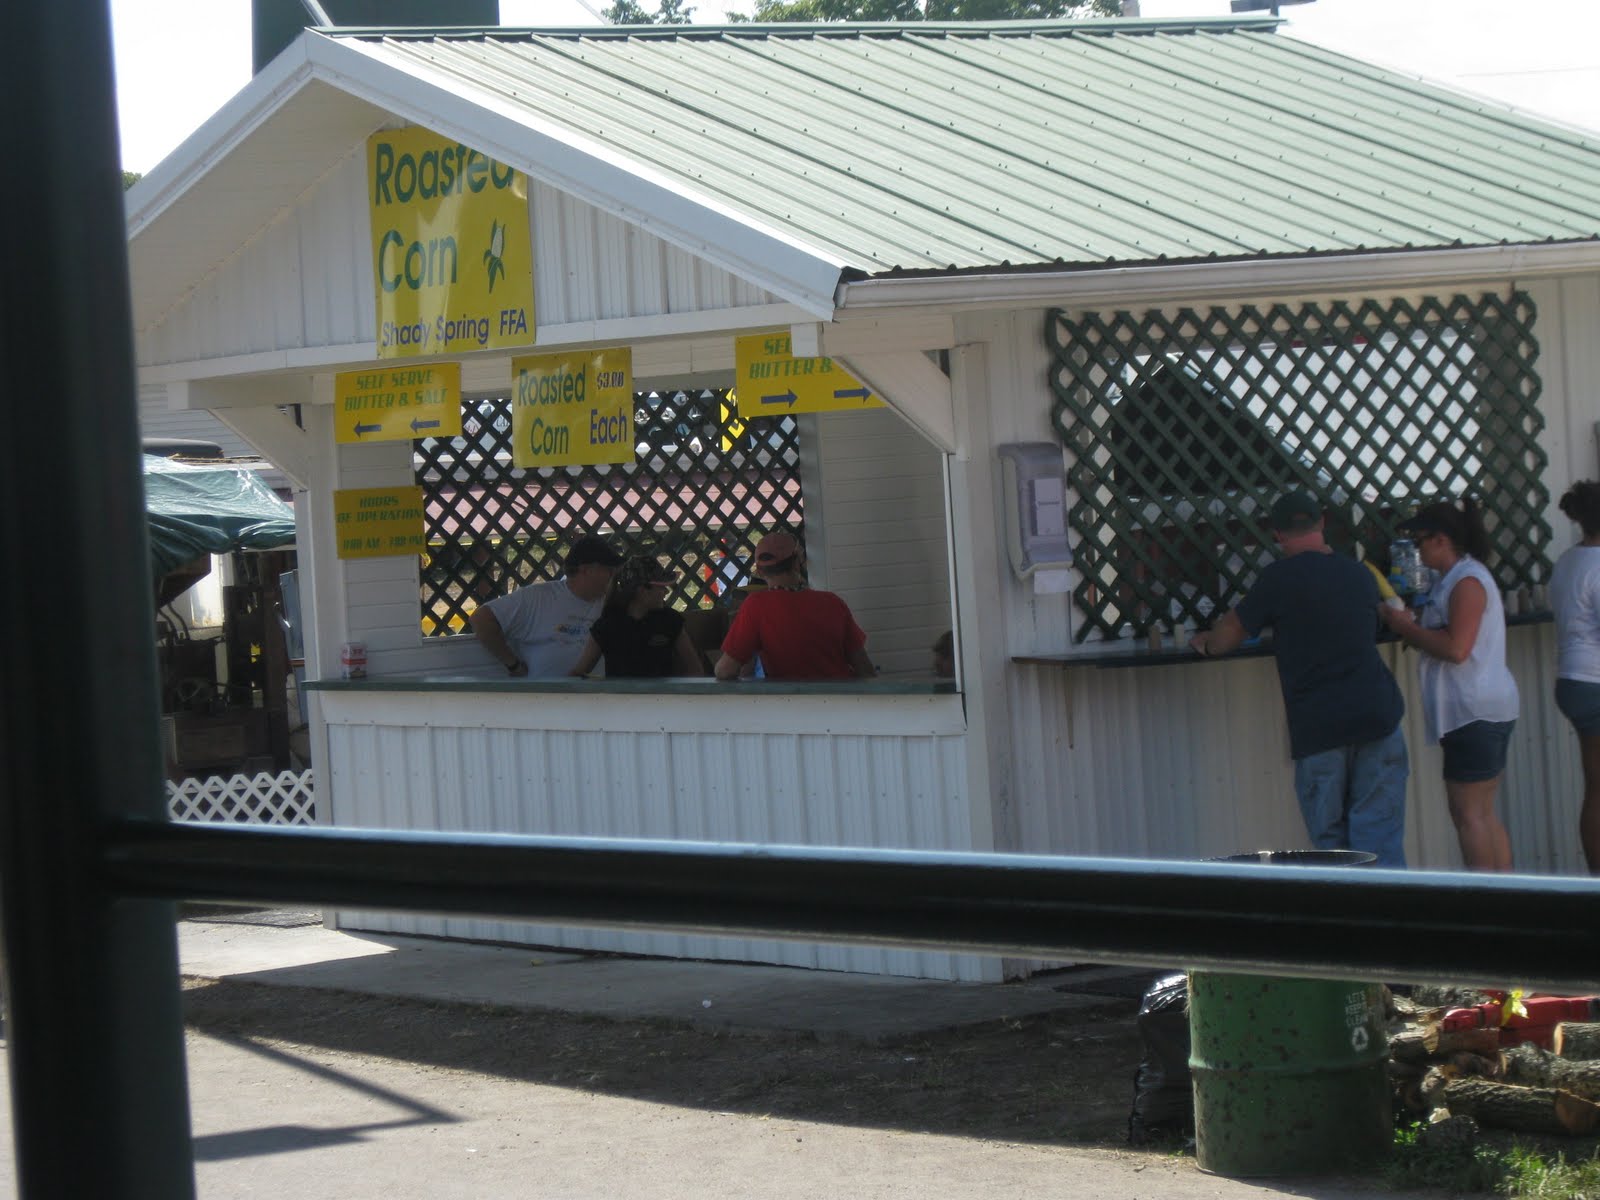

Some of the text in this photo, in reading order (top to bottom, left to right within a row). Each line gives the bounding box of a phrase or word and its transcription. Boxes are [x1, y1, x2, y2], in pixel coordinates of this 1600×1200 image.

[376, 143, 514, 205] Roasted
[378, 229, 457, 293] Corn
[382, 308, 528, 349] Shady Spring FFA
[356, 369, 434, 390] SELF SERVE
[518, 362, 586, 407] Roasted
[749, 357, 815, 379] BUTTER
[344, 393, 396, 412] BUTTER
[414, 388, 449, 406] SALT
[530, 416, 570, 456] Corn
[589, 407, 628, 446] Each
